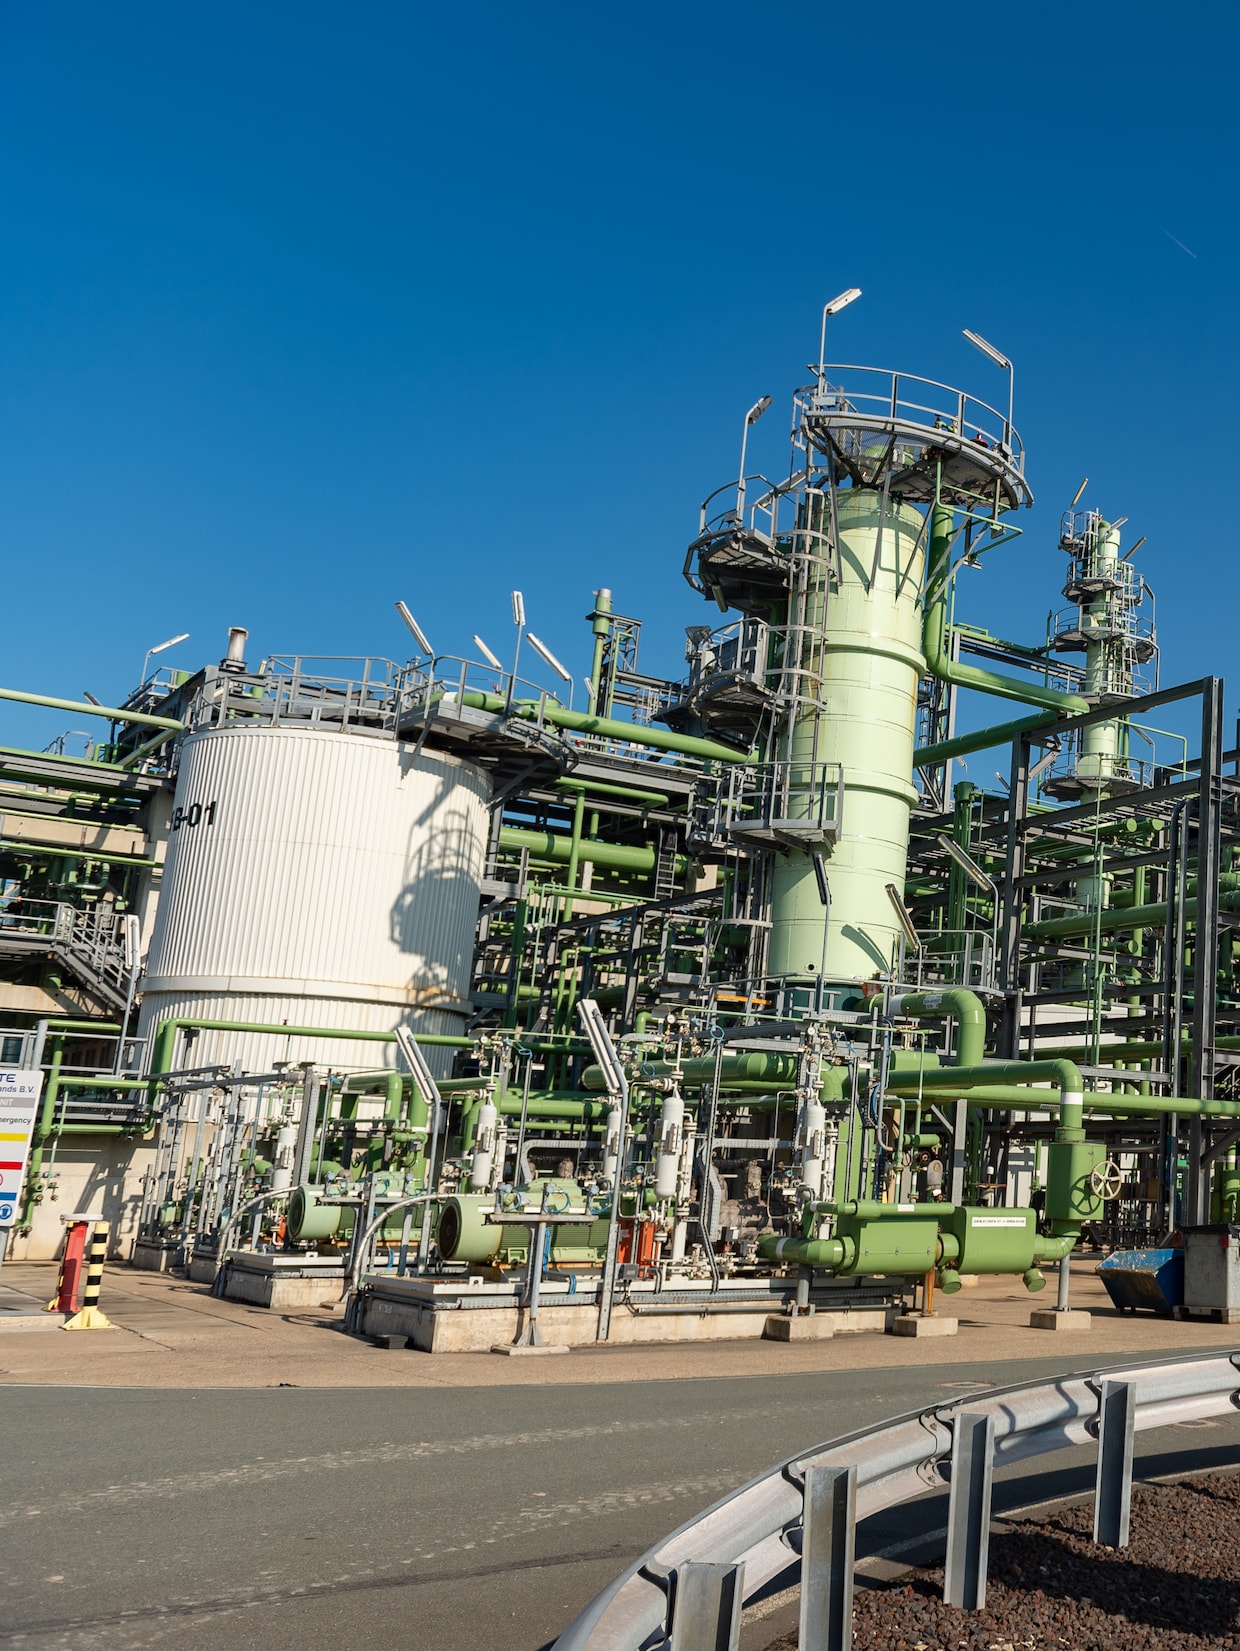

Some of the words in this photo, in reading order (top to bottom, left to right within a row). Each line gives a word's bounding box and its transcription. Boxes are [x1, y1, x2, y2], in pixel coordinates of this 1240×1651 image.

[0, 1085, 17, 1093] nds
[19, 1085, 35, 1094] B.V.
[0, 1117, 32, 1126] ergency
